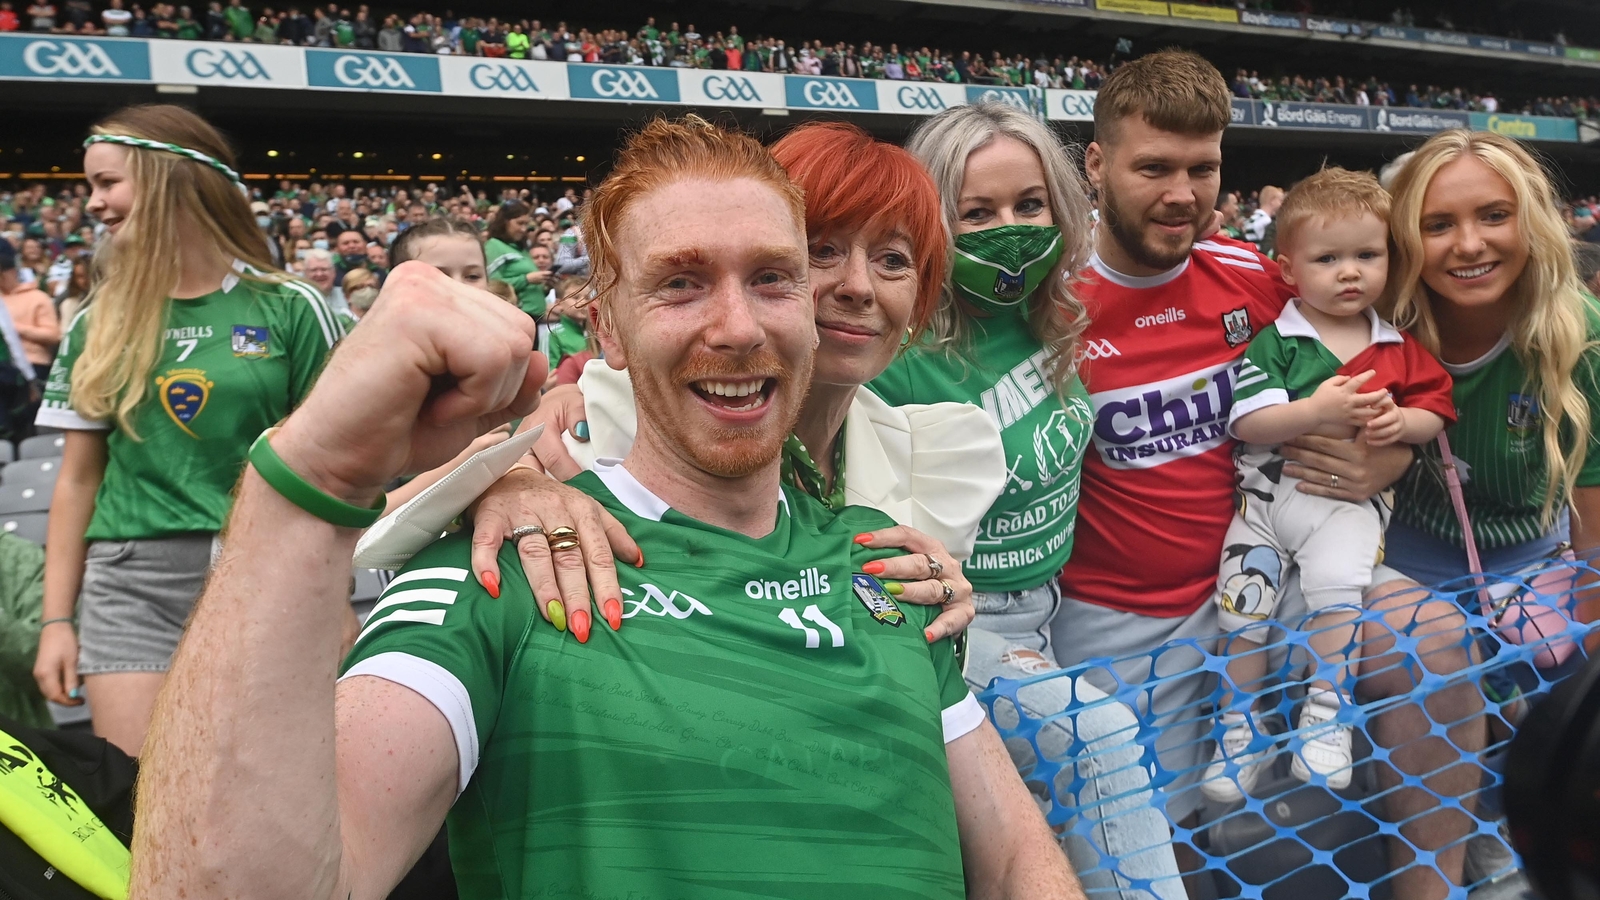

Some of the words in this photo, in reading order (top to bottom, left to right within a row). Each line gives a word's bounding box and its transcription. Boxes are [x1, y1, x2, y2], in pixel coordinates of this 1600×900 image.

[23, 40, 122, 76] GAA
[186, 48, 272, 80] GAA
[334, 55, 415, 88] GAA
[470, 63, 539, 92] GAA
[591, 69, 658, 99] GAA
[703, 75, 762, 102] GAA
[803, 80, 859, 107] GAA
[897, 86, 946, 110] GAA
[1277, 107, 1303, 123] Bord
[176, 339, 198, 362] 7
[1094, 364, 1242, 445] Chil
[1104, 421, 1228, 462] INSURAN
[996, 506, 1046, 534] ROAD
[1049, 493, 1067, 516] TO
[966, 545, 1044, 570] LIMERICK
[778, 604, 844, 648] 11
